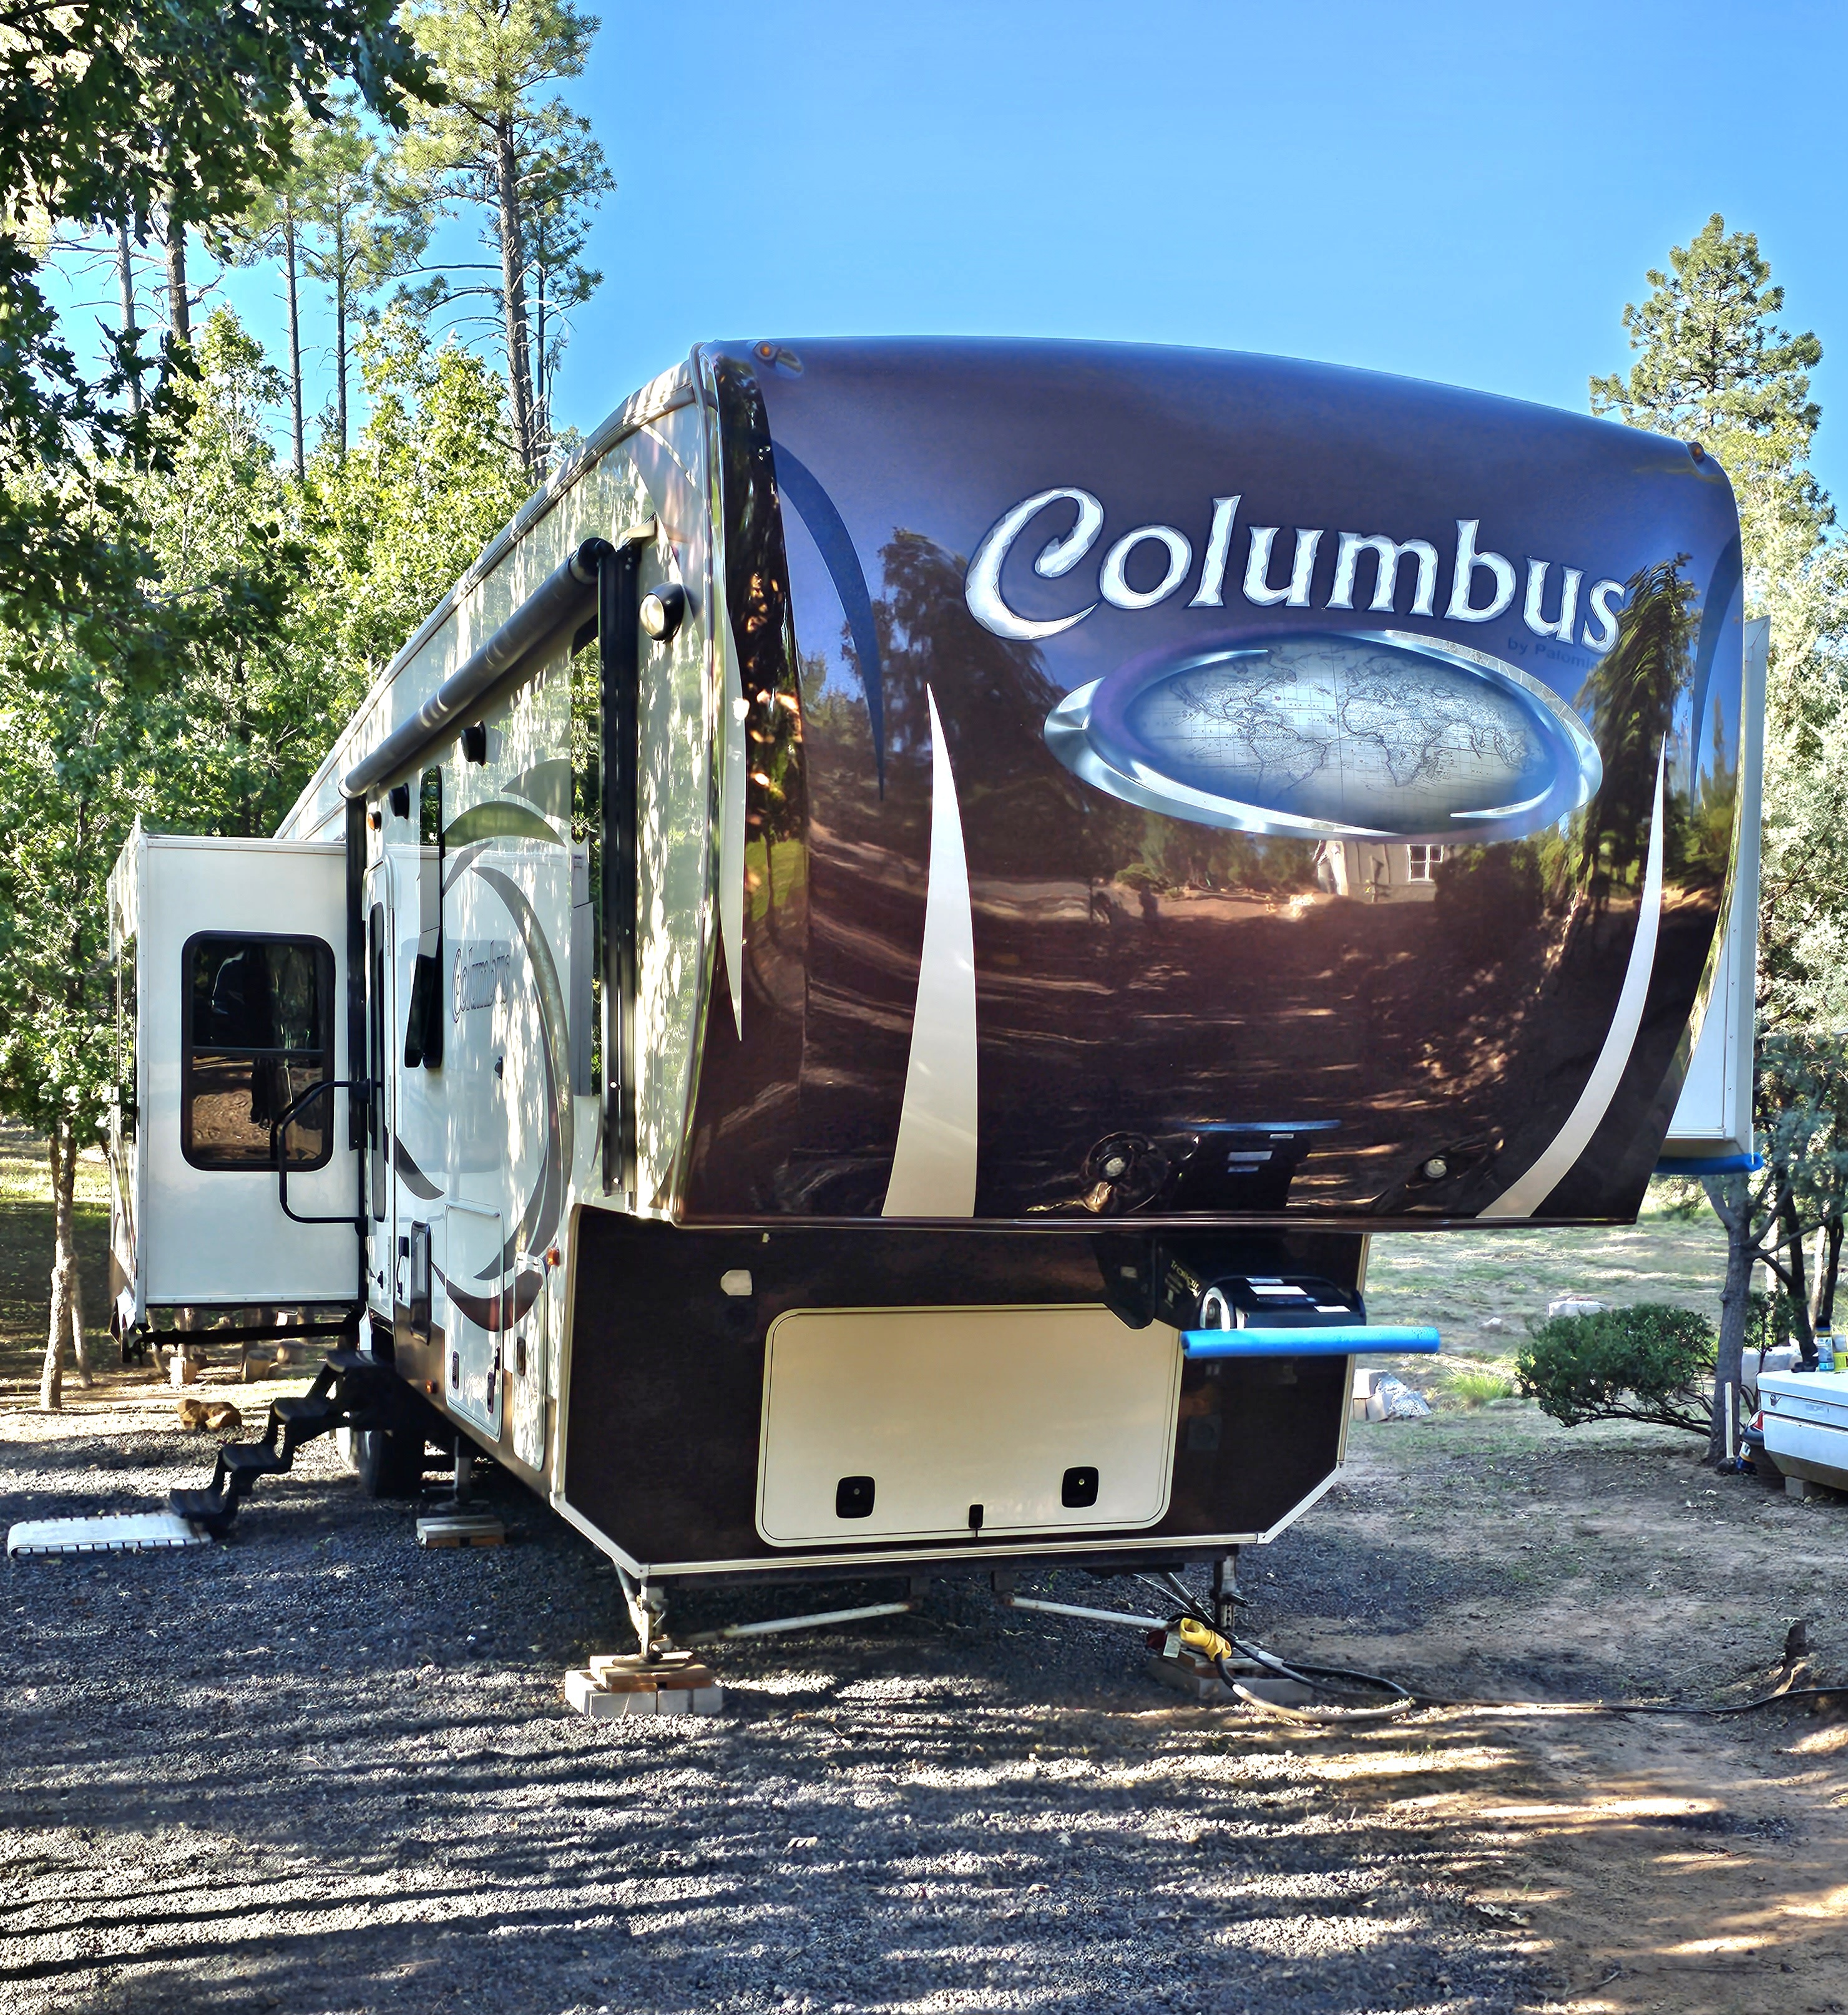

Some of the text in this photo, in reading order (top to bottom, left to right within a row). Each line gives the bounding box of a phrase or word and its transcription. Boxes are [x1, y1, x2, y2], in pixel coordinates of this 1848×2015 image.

[964, 486, 1625, 654] Columbus
[1507, 637, 1528, 655] by
[452, 940, 511, 1023] Columbus
